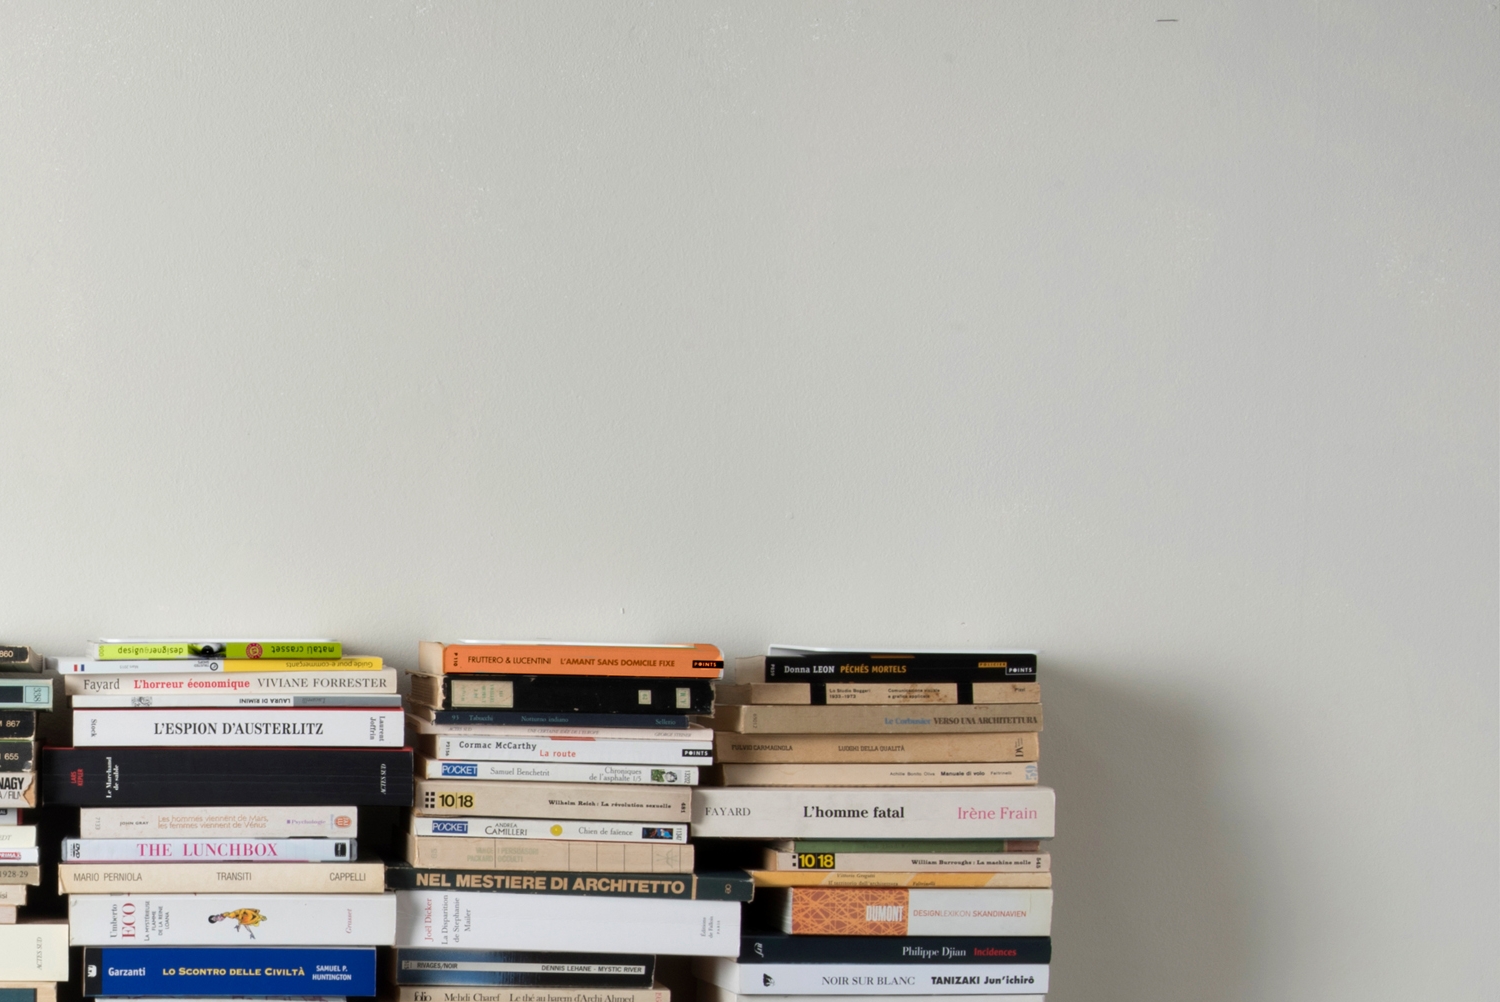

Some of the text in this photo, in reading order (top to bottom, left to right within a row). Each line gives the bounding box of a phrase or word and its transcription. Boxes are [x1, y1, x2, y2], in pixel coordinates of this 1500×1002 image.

[784, 664, 907, 674] Donna LEON PÉCHÉS MORTELS
[83, 678, 120, 694] Fayard
[133, 679, 250, 691] L'horreur économique
[257, 678, 388, 689] VIVIANE FORRESTER
[154, 723, 324, 735] L'ESPION D'AUSTERLITZ
[459, 741, 537, 752] Cormac McCarthy
[539, 750, 550, 758] La
[442, 764, 477, 776] POCKET
[705, 807, 751, 816] FAYARD
[803, 806, 905, 819] L'homme fatal
[957, 806, 1038, 820] Irène Frain
[136, 842, 278, 857] THE LUNCHBOX
[74, 873, 143, 882] MARIO PERNIOLA
[216, 873, 252, 881] TRANSITI
[329, 872, 366, 882] CAPPELLI
[416, 873, 685, 894] NEL MESTIERE DI ARCHITETTO
[866, 905, 904, 922] DUMONT
[121, 903, 136, 940] ECO
[902, 946, 967, 958] Philippe Djian
[974, 947, 1017, 957] Incidences
[108, 966, 146, 977] Garzanti
[162, 966, 305, 977] LO SCONTRO DELLE CIVILTÀ
[931, 976, 981, 985] TANIZAKI
